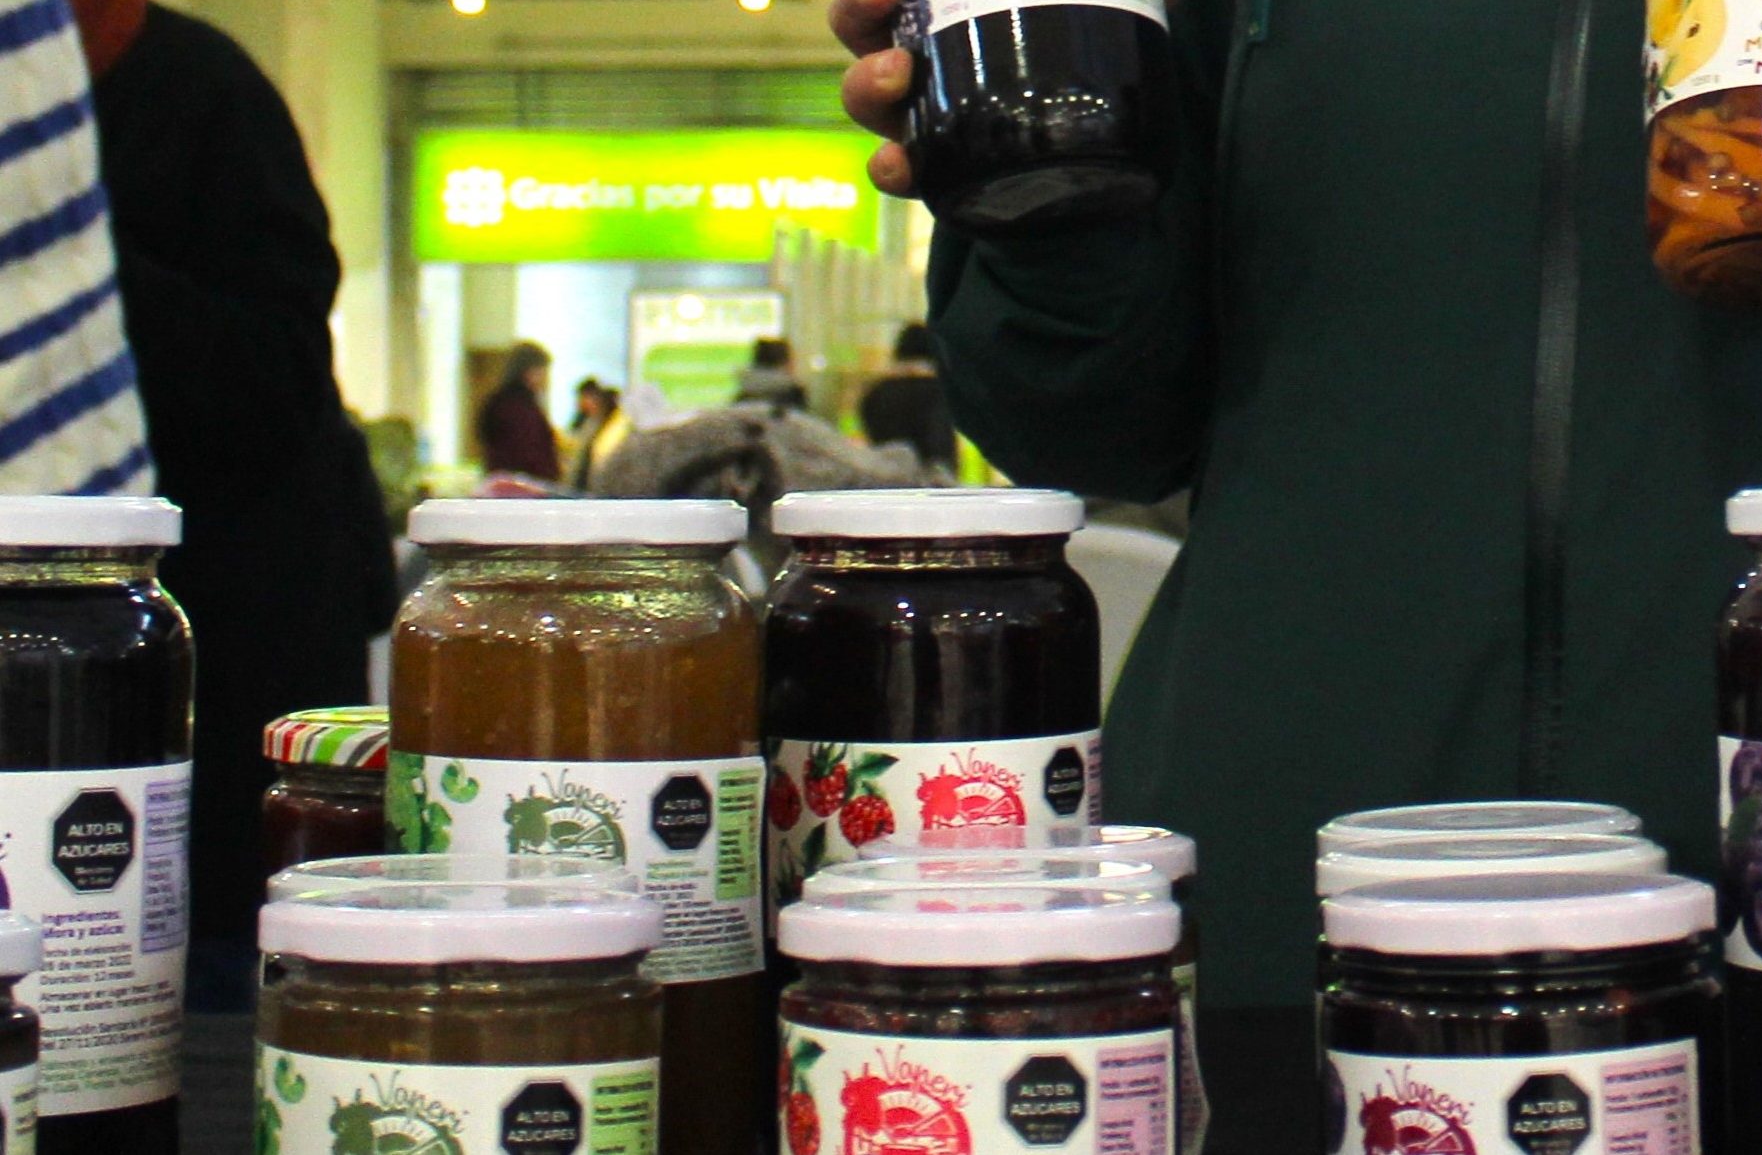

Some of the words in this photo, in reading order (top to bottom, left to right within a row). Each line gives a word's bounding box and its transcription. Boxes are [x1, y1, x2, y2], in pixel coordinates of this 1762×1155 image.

[510, 177, 635, 210] Gracias
[644, 183, 704, 213] por
[711, 183, 753, 210] su
